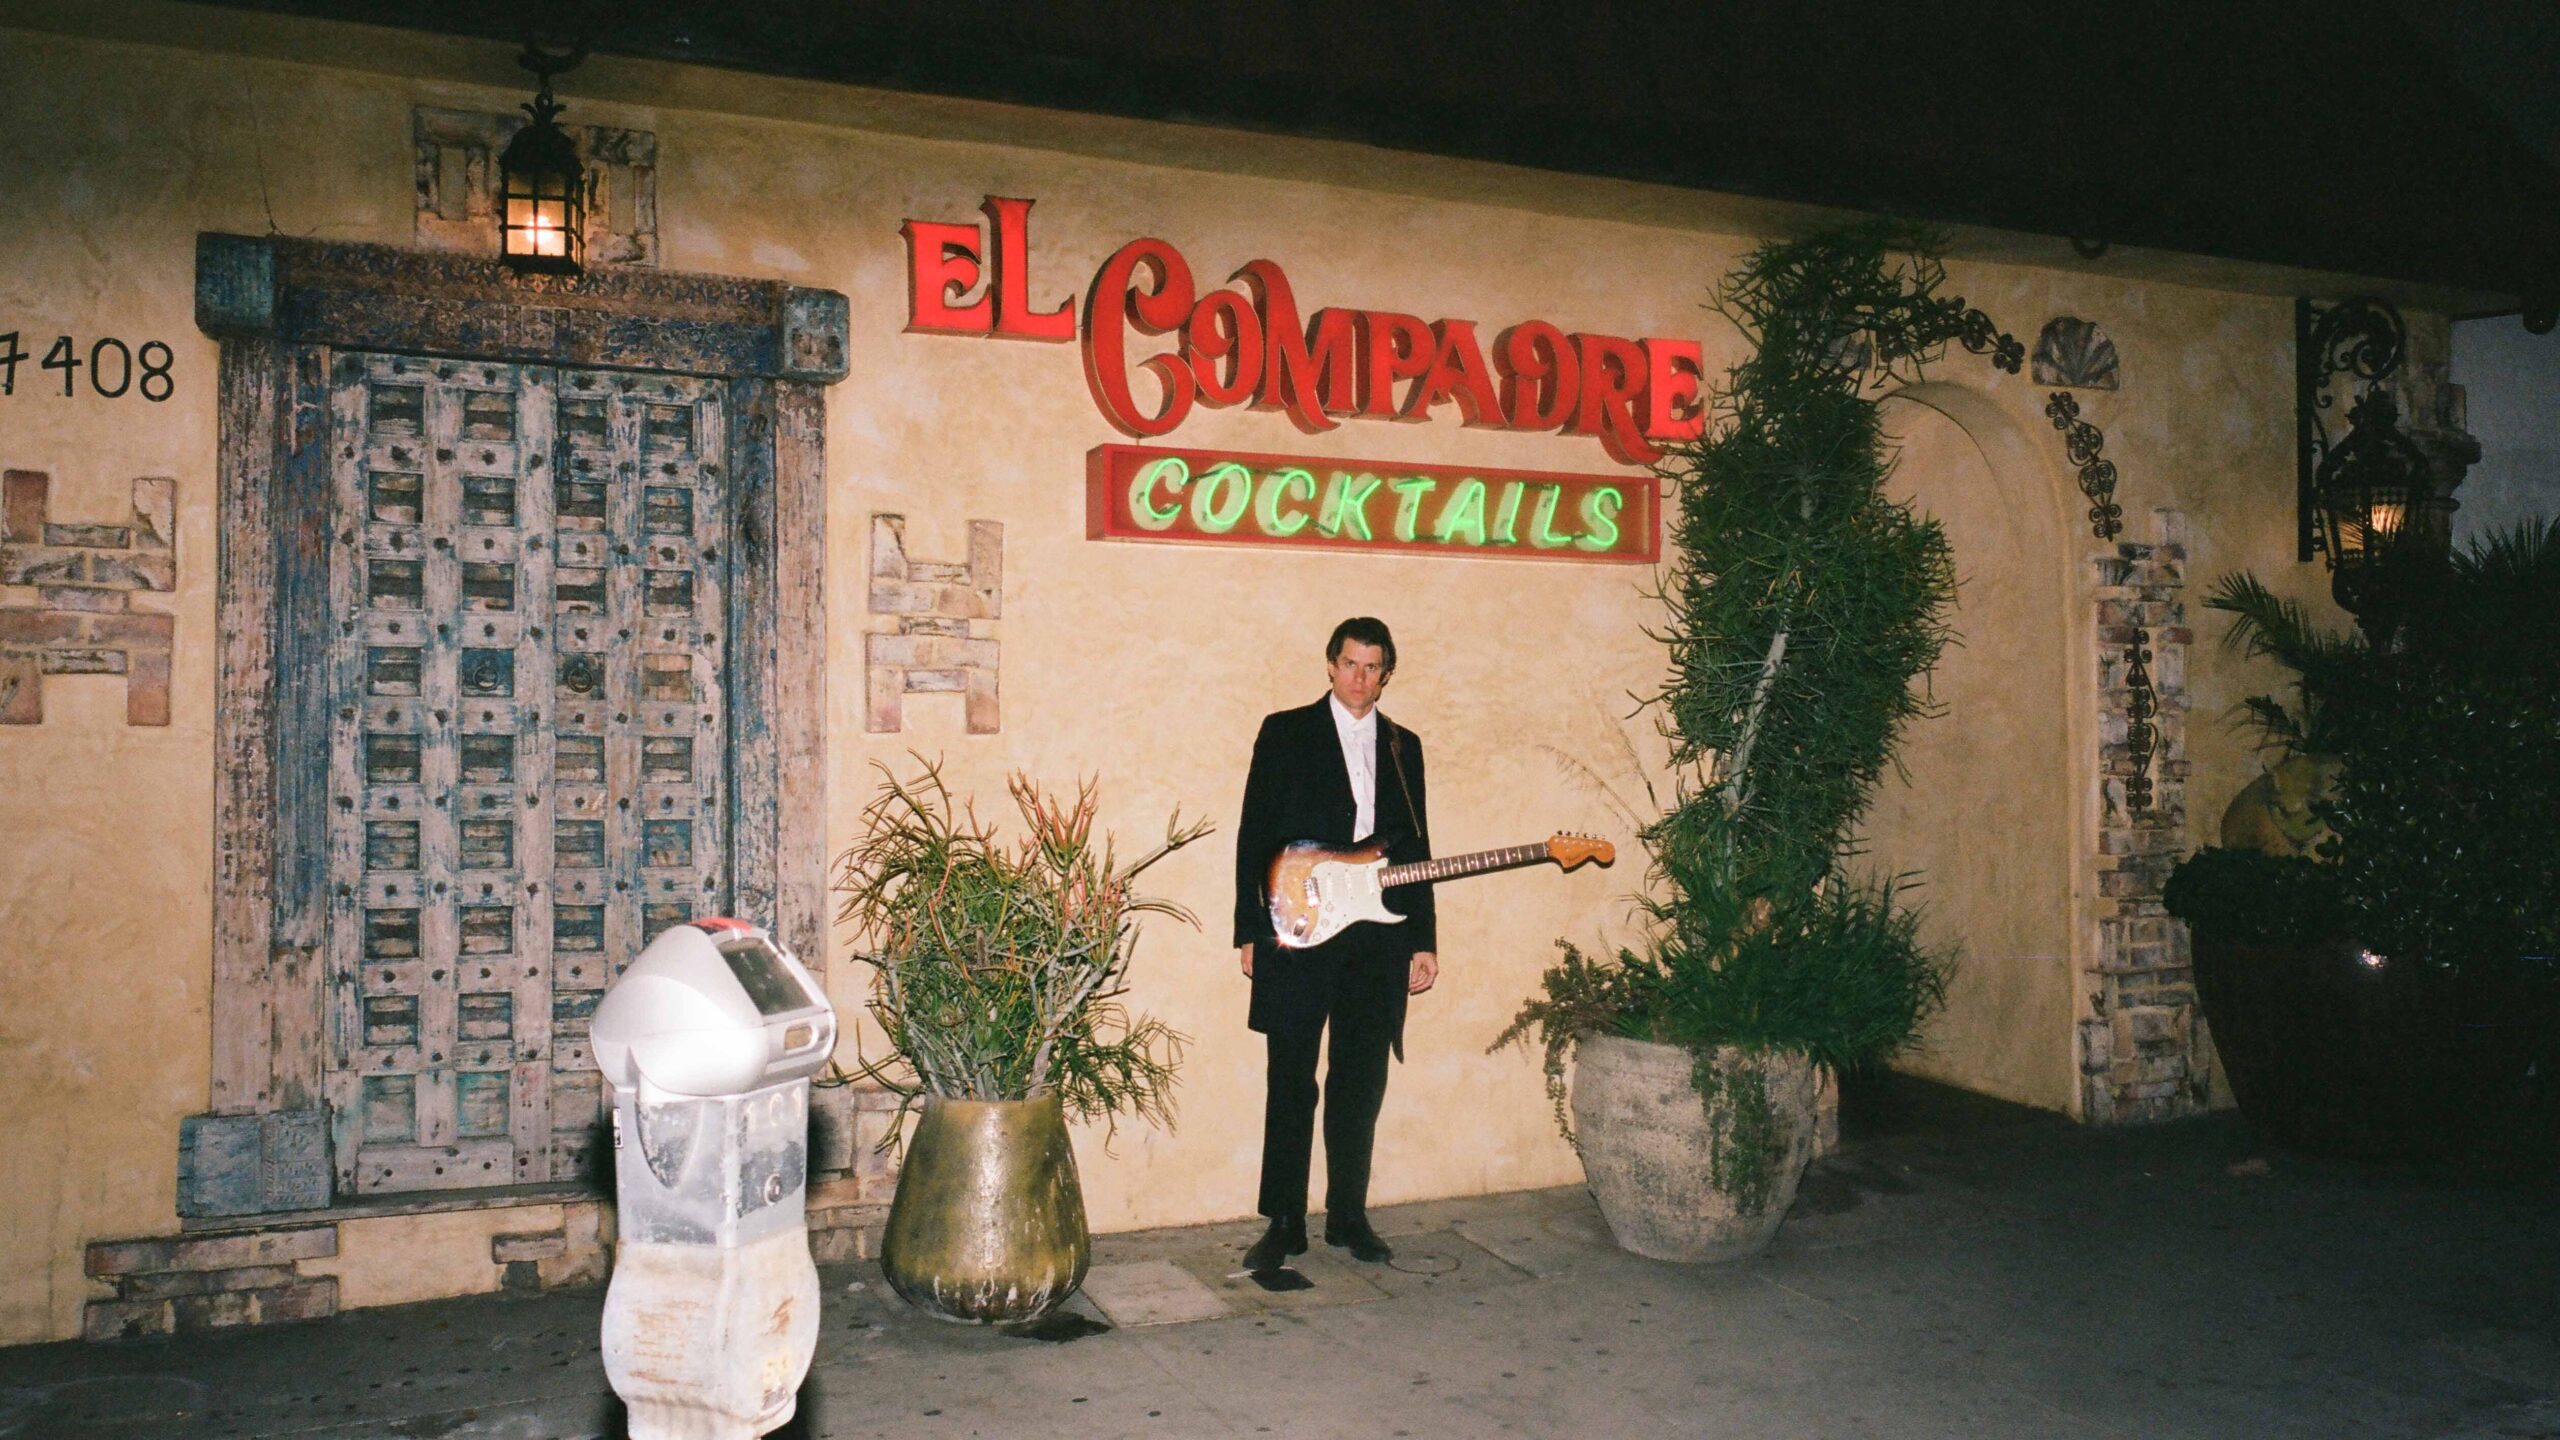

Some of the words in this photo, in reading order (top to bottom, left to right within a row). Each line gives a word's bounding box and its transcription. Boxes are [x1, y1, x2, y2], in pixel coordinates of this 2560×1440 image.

[898, 195, 1076, 343] EL
[0, 331, 174, 402] 7408
[1129, 457, 1623, 551] COCKTAILS
